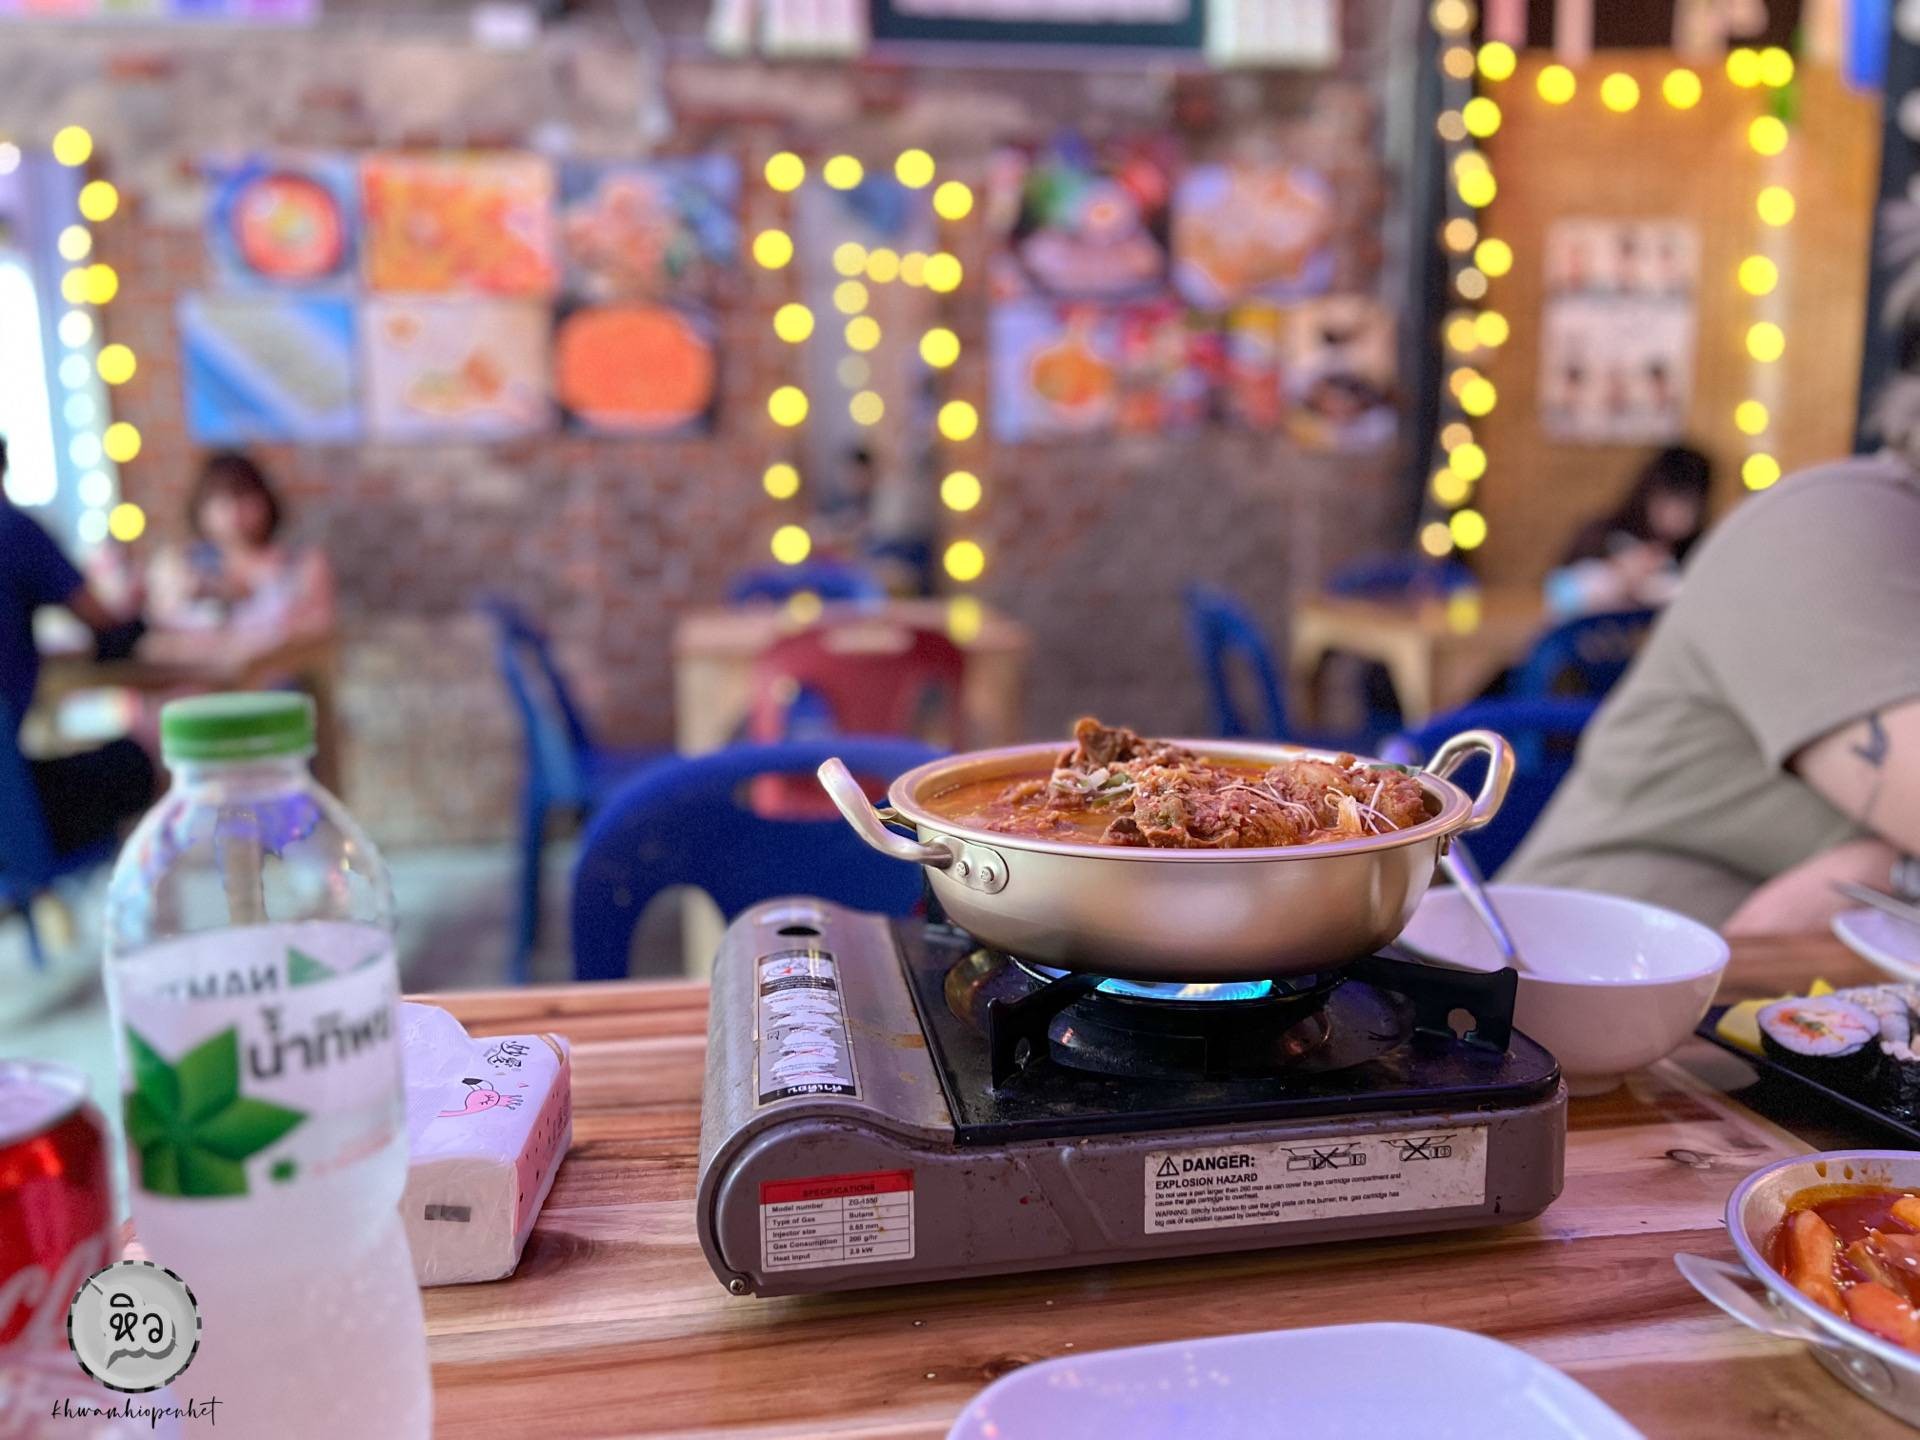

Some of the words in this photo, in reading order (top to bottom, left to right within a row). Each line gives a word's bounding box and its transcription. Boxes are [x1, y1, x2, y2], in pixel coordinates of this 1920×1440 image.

[1182, 1154, 1256, 1172] DANGER:
[1155, 1177, 1213, 1190] EXPLOSION
[1216, 1173, 1258, 1185] HAZARD
[1352, 1174, 1389, 1182] compartment
[803, 1184, 876, 1198] SPECIFICATIONS
[1363, 1192, 1388, 1200] cartridge
[772, 1205, 794, 1213] Model
[796, 1203, 824, 1211] number
[772, 1230, 800, 1239] Injector
[790, 1239, 838, 1248] Consumption
